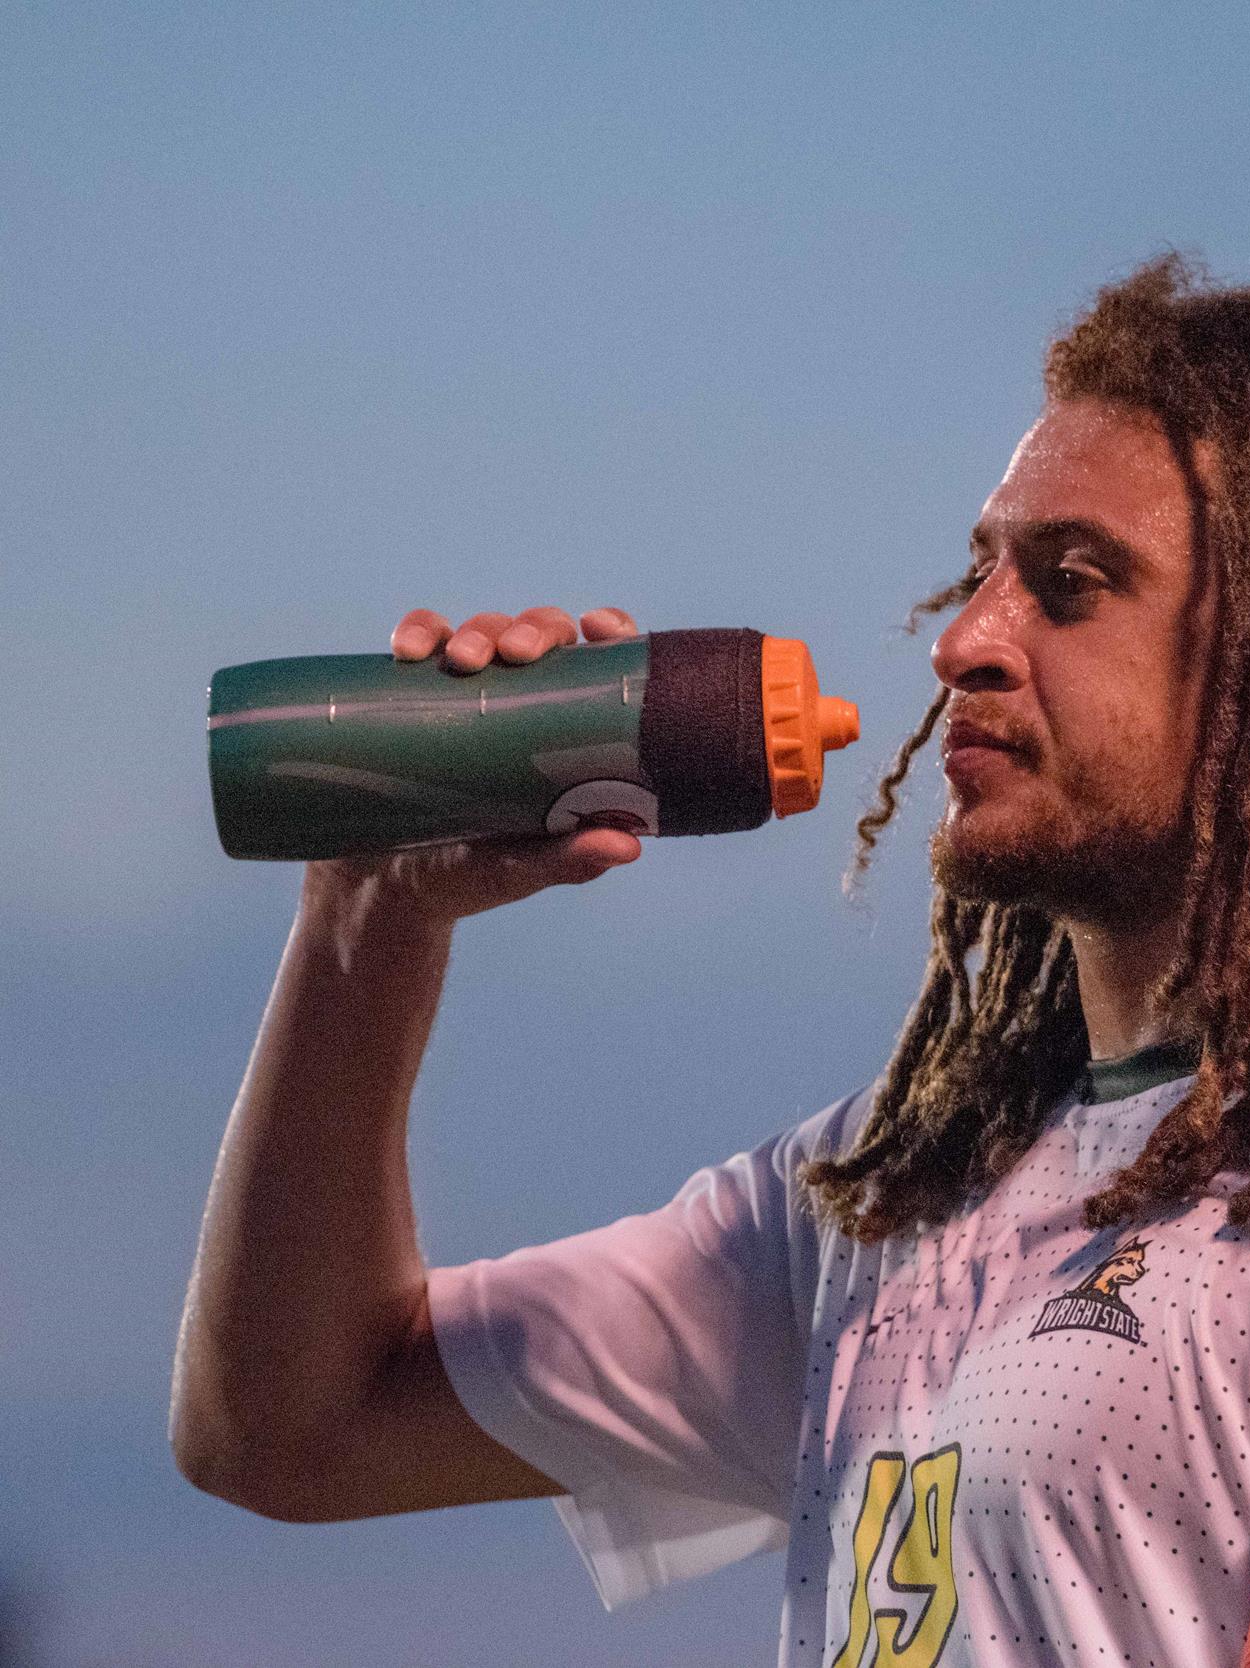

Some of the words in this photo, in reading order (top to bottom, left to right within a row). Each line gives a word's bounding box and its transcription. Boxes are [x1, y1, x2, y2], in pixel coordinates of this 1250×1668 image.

[1035, 1299, 1103, 1331] WRIGHT
[1099, 1306, 1140, 1340] STATE
[832, 1442, 962, 1668] 19
